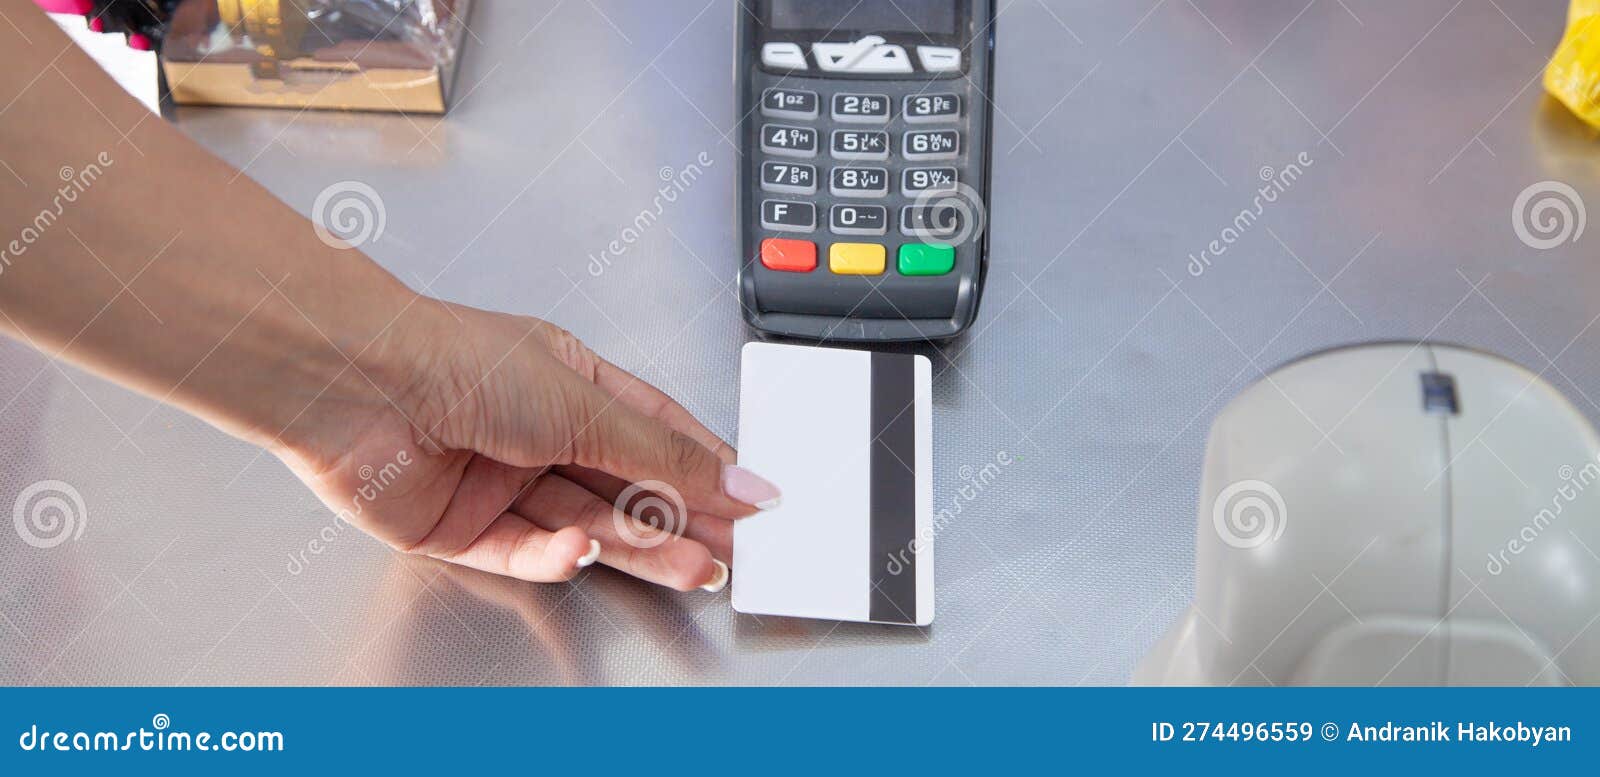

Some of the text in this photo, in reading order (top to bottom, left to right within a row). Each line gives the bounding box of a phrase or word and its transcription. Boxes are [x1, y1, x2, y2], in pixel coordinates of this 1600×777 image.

[772, 91, 785, 109] 1
[843, 96, 859, 113] 2
[915, 97, 931, 114] 3
[771, 129, 788, 146] 4
[843, 133, 858, 150] 5
[913, 134, 929, 152] 6
[773, 165, 788, 182] 7
[842, 170, 858, 187] 8
[912, 171, 928, 188] 9
[774, 204, 789, 222] F
